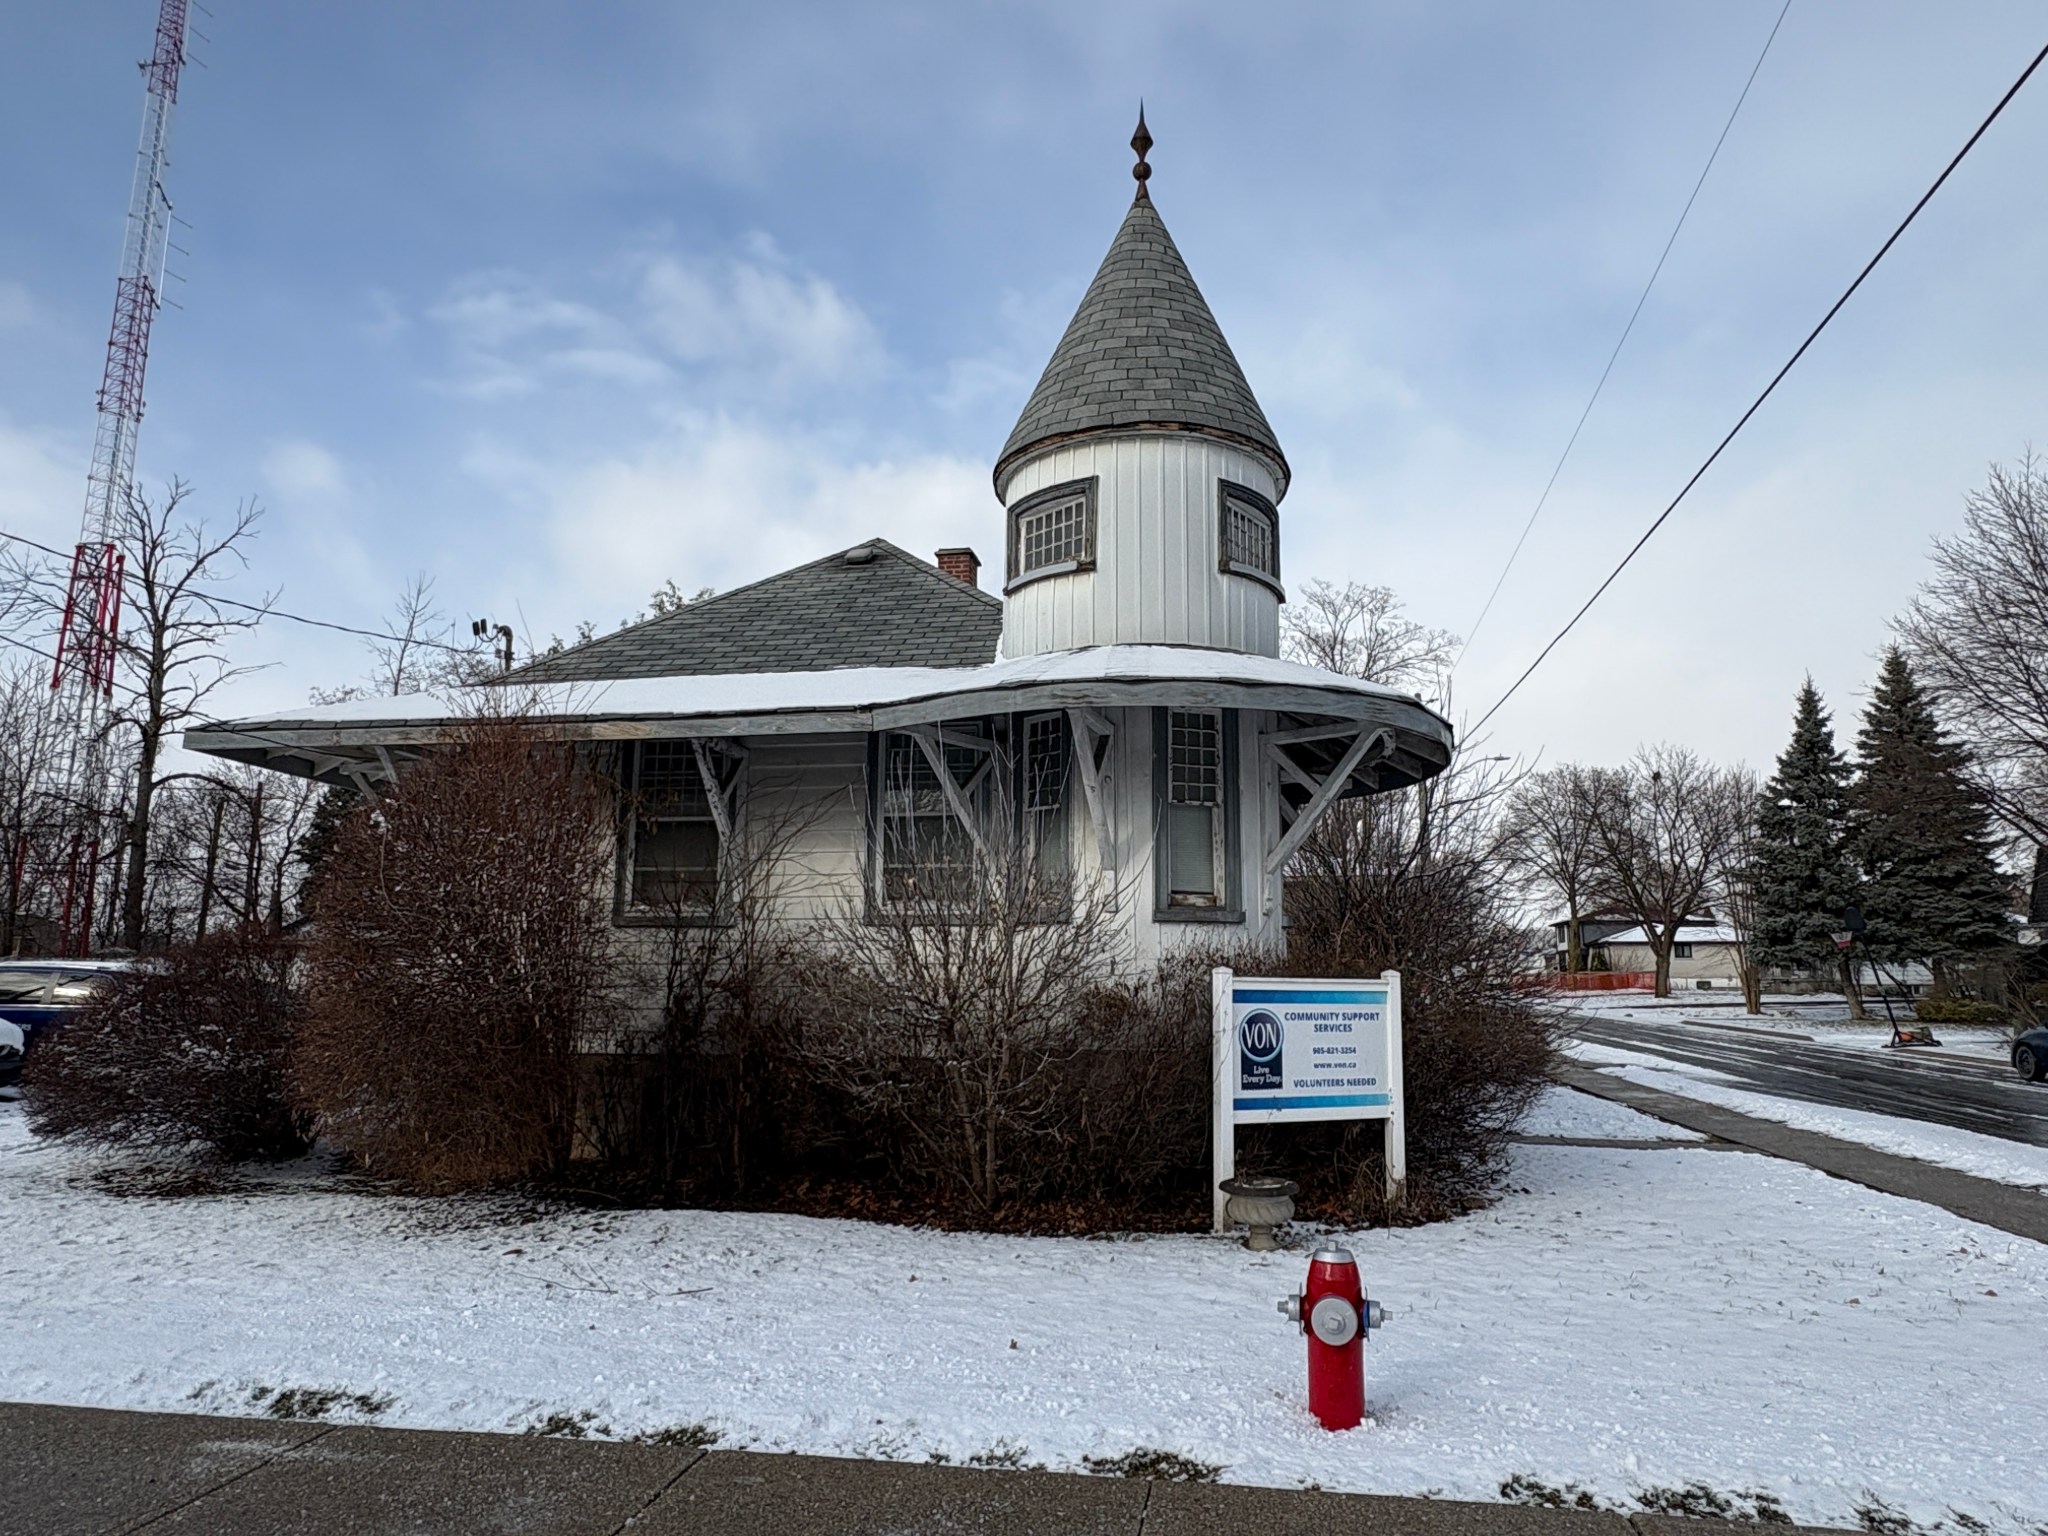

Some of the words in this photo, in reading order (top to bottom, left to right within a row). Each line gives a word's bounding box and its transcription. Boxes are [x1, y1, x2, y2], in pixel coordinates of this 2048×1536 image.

[1284, 1012, 1340, 1022] COMMUNITY
[1341, 1012, 1380, 1021] SUPPORT
[1313, 1024, 1353, 1033] SERVICES
[1244, 1023, 1277, 1049] VON
[1253, 1065, 1270, 1074] Live
[1242, 1074, 1265, 1085] Every
[1293, 1079, 1345, 1088] VOLUNTEERS
[1346, 1078, 1377, 1087] NEEDED
